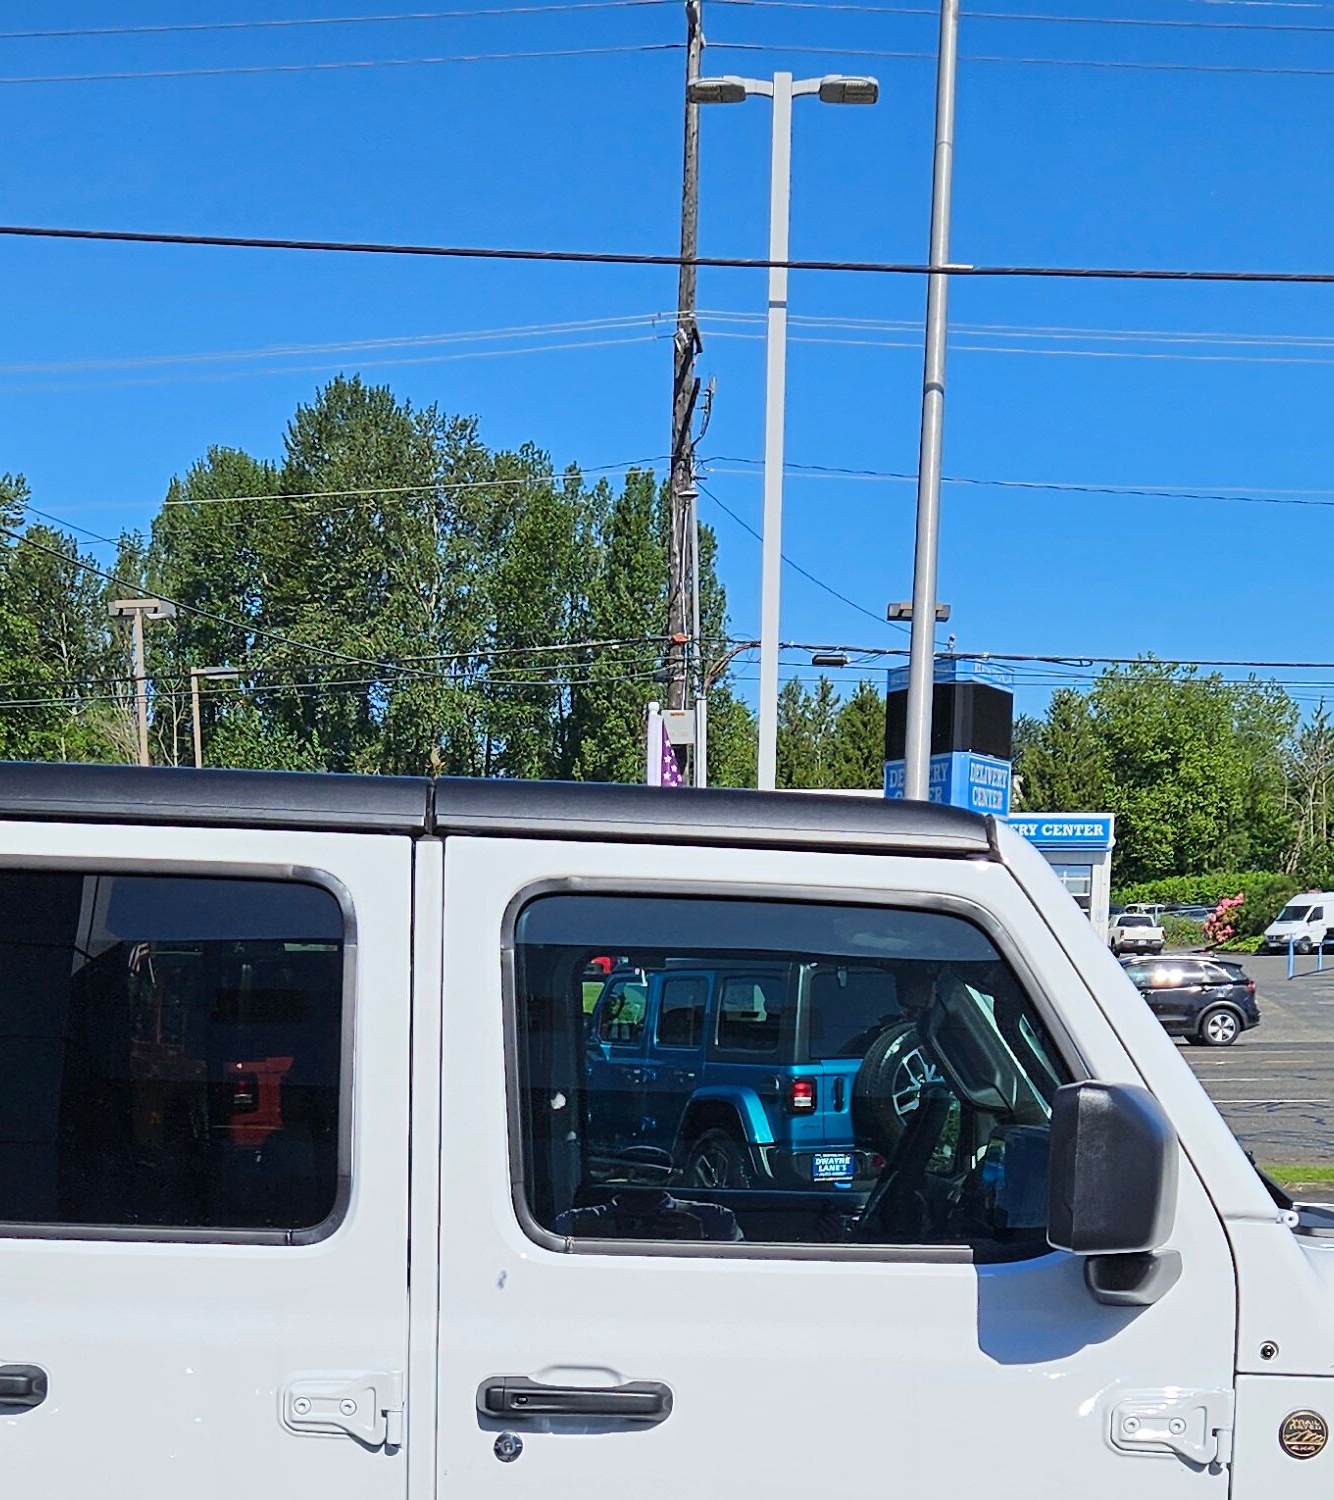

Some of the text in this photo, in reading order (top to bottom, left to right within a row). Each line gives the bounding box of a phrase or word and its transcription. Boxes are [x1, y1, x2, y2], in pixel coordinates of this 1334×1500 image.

[970, 762, 1008, 788] DELIVERY
[972, 786, 1003, 809] CENTER
[1041, 823, 1104, 836] CENTER
[815, 1156, 851, 1166] DWAYNE
